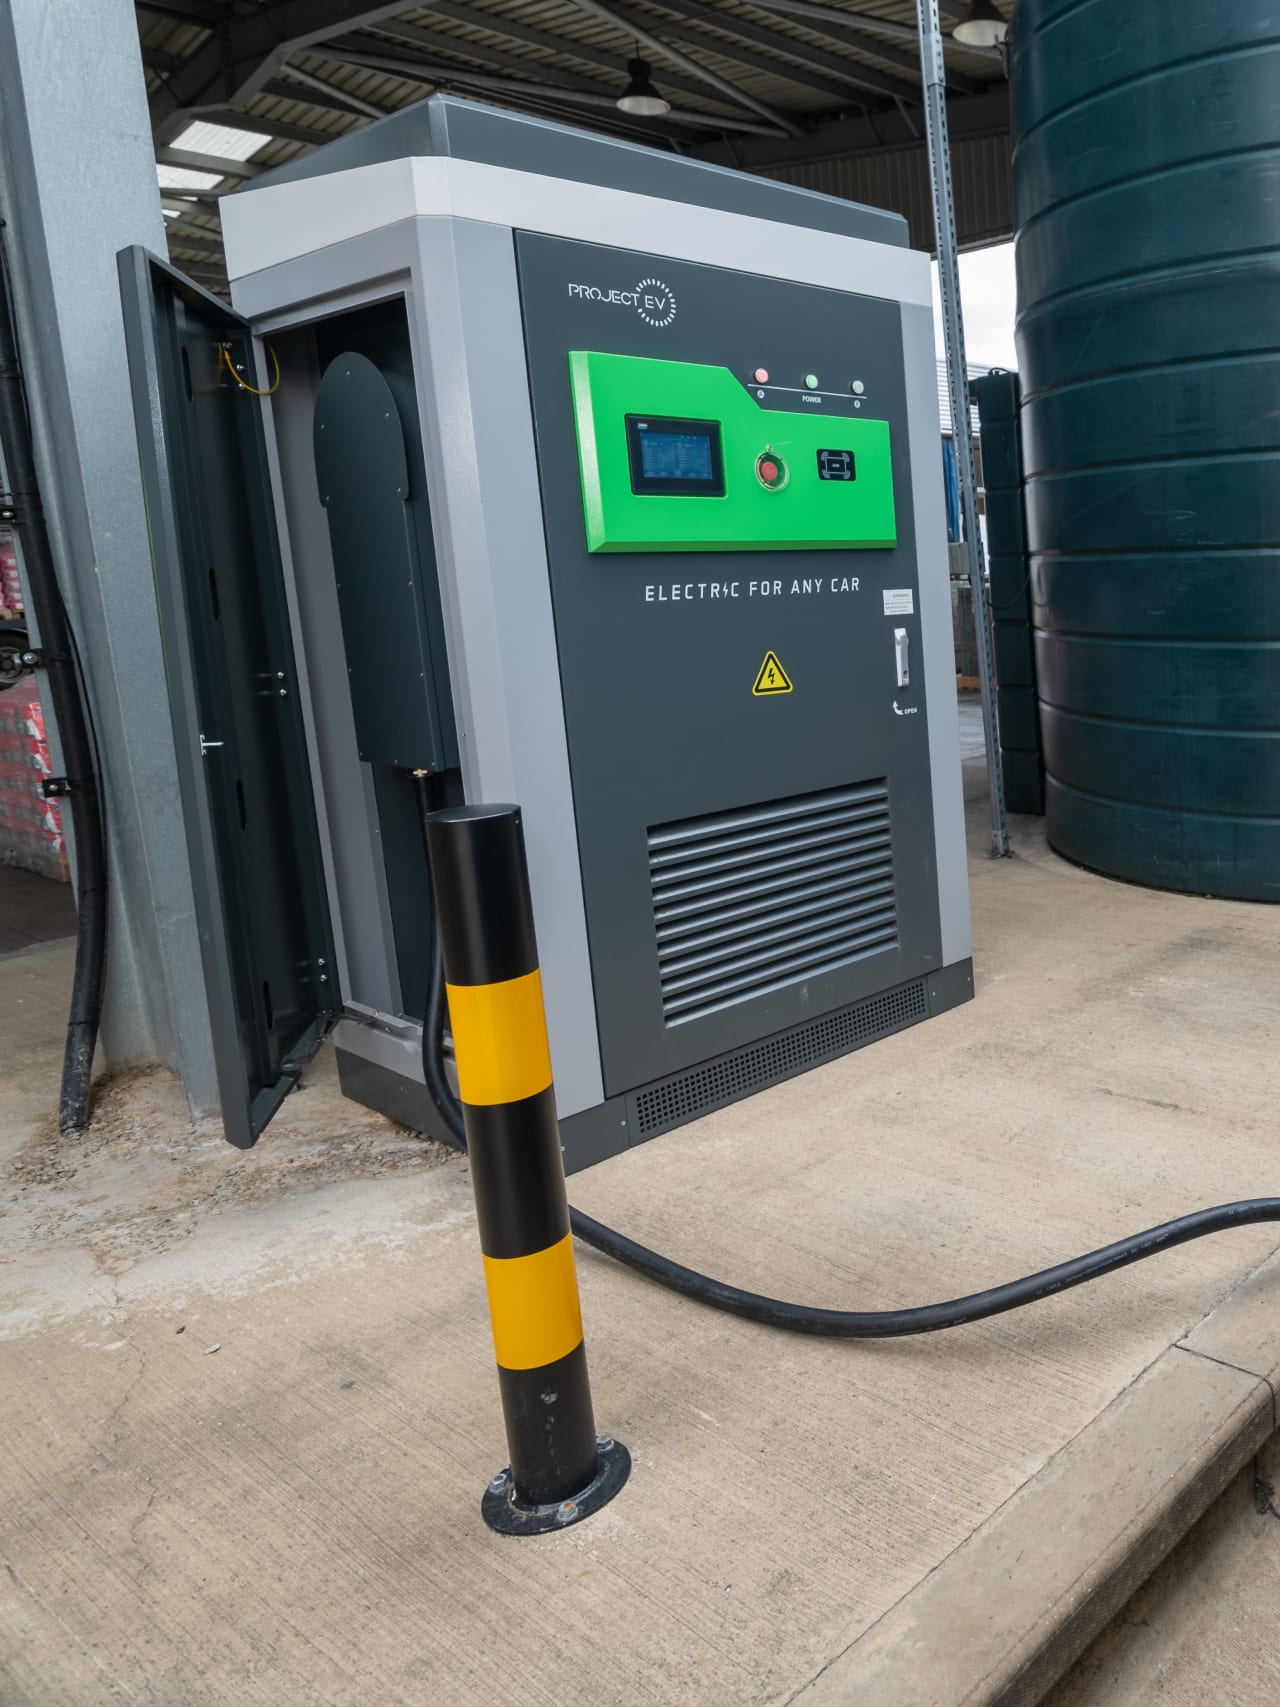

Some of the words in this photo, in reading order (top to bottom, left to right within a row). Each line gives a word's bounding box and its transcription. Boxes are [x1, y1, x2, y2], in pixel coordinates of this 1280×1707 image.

[568, 283, 640, 307] PROJECT
[644, 295, 666, 310] EV
[802, 395, 822, 404] POWER
[645, 582, 739, 601] ELECTRIC
[749, 580, 782, 596] FOR
[791, 578, 824, 594] ANY
[831, 577, 860, 592] CAR
[904, 707, 918, 715] OPEN
